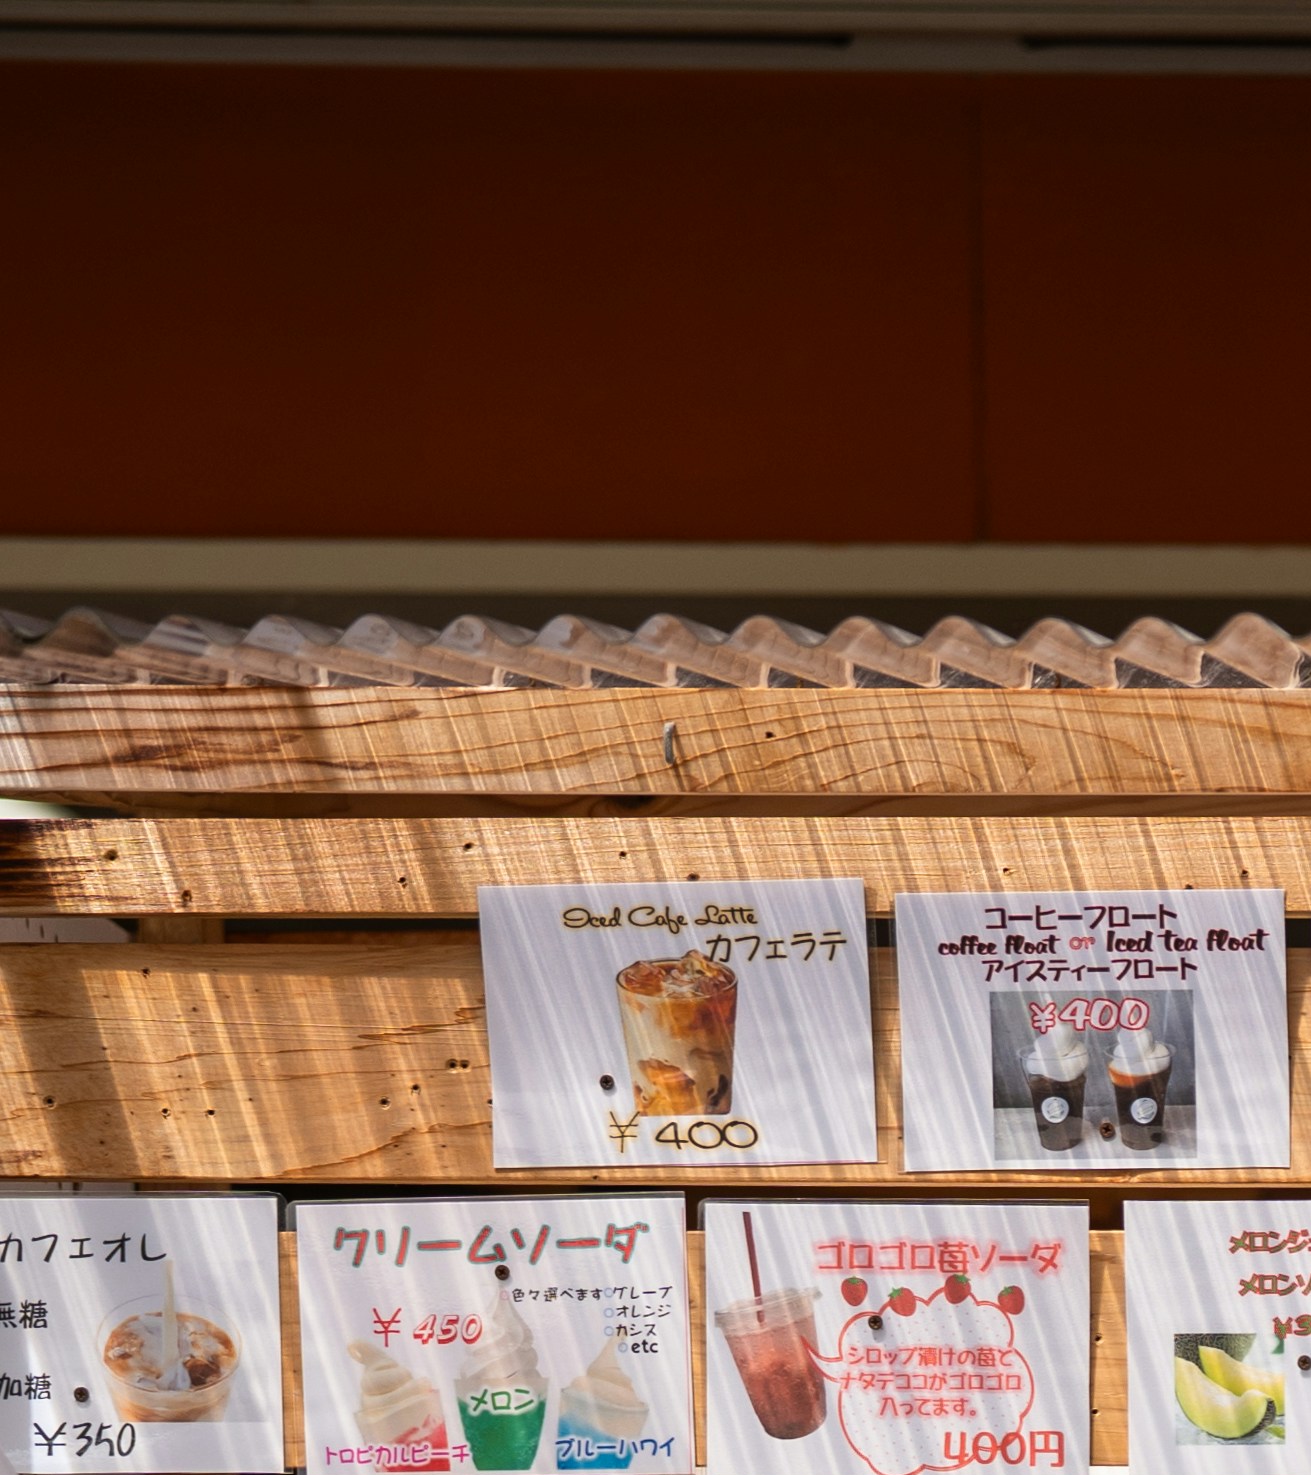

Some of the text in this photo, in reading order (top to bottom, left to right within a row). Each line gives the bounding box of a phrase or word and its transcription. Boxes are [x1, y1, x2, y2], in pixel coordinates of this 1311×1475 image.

[986, 906, 1177, 929] コーヒーフロート
[707, 935, 847, 963] カフェラテ
[939, 929, 1264, 956] coffee float tea float
[983, 957, 1197, 982] アイスティーフロート
[1031, 998, 1149, 1033] ¥400
[333, 1222, 649, 1267] クリームソーダ
[817, 1242, 1061, 1273] ゴロゴロ苺ソーダ
[616, 1304, 672, 1318] オレンジ
[616, 1323, 657, 1336] カシス
[631, 1340, 659, 1353] etc
[841, 1372, 1021, 1391] ナタデココがゴロゴロ
[470, 1388, 535, 1411] メロン
[325, 1438, 675, 1465] トロピカルピーチ ブルーハワイ
[944, 1431, 1065, 1467] 400円
